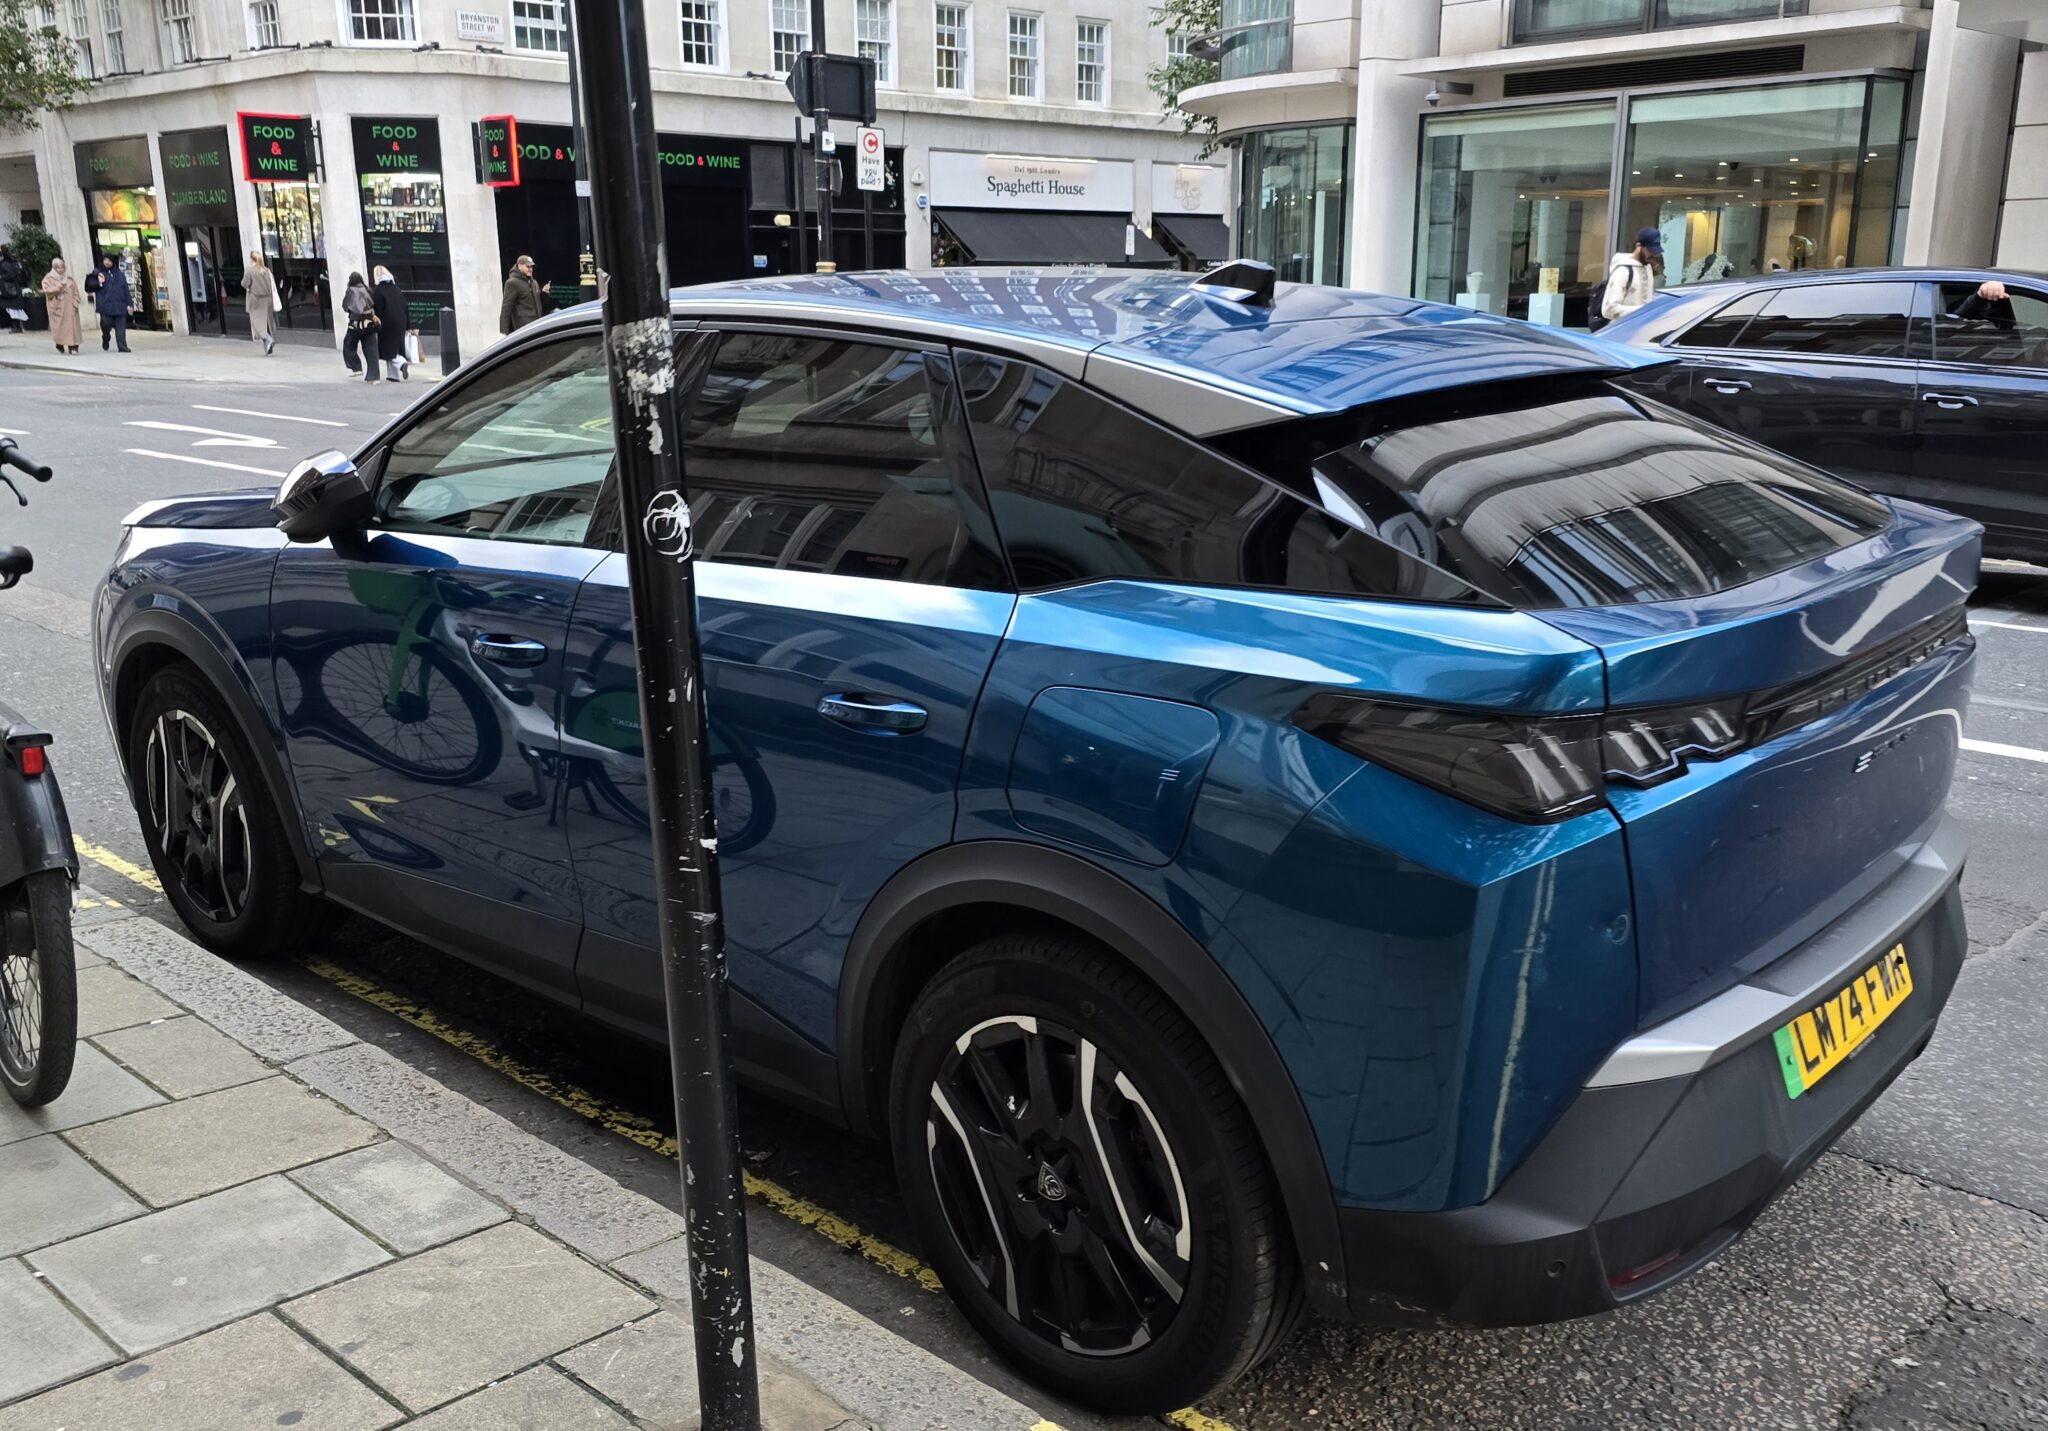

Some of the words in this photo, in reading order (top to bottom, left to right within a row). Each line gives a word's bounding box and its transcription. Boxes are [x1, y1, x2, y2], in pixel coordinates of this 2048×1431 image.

[460, 13, 499, 24] BRYANSTON
[461, 22, 485, 32] STREET
[252, 125, 295, 140] FOOD
[372, 126, 417, 139] FOOD
[484, 129, 504, 141] FOOD
[270, 141, 282, 155] &
[392, 141, 400, 151] &
[492, 144, 499, 158] &
[517, 144, 551, 160] OOD
[555, 148, 563, 160] &
[89, 158, 109, 171] FOOD
[169, 154, 191, 168] FOOD
[198, 151, 220, 167] WINE
[258, 157, 298, 171] WINE
[376, 154, 419, 168] WINE
[657, 152, 695, 166] FOOD
[697, 156, 704, 166] &
[706, 155, 741, 168] WINE
[862, 156, 880, 165] Have
[487, 161, 507, 173] WINE
[864, 168, 878, 176] you
[987, 175, 1044, 197] Spaghetti
[1048, 180, 1085, 196] House
[171, 188, 227, 208] CUMBERLAND
[1792, 986, 1864, 1074] LM74
